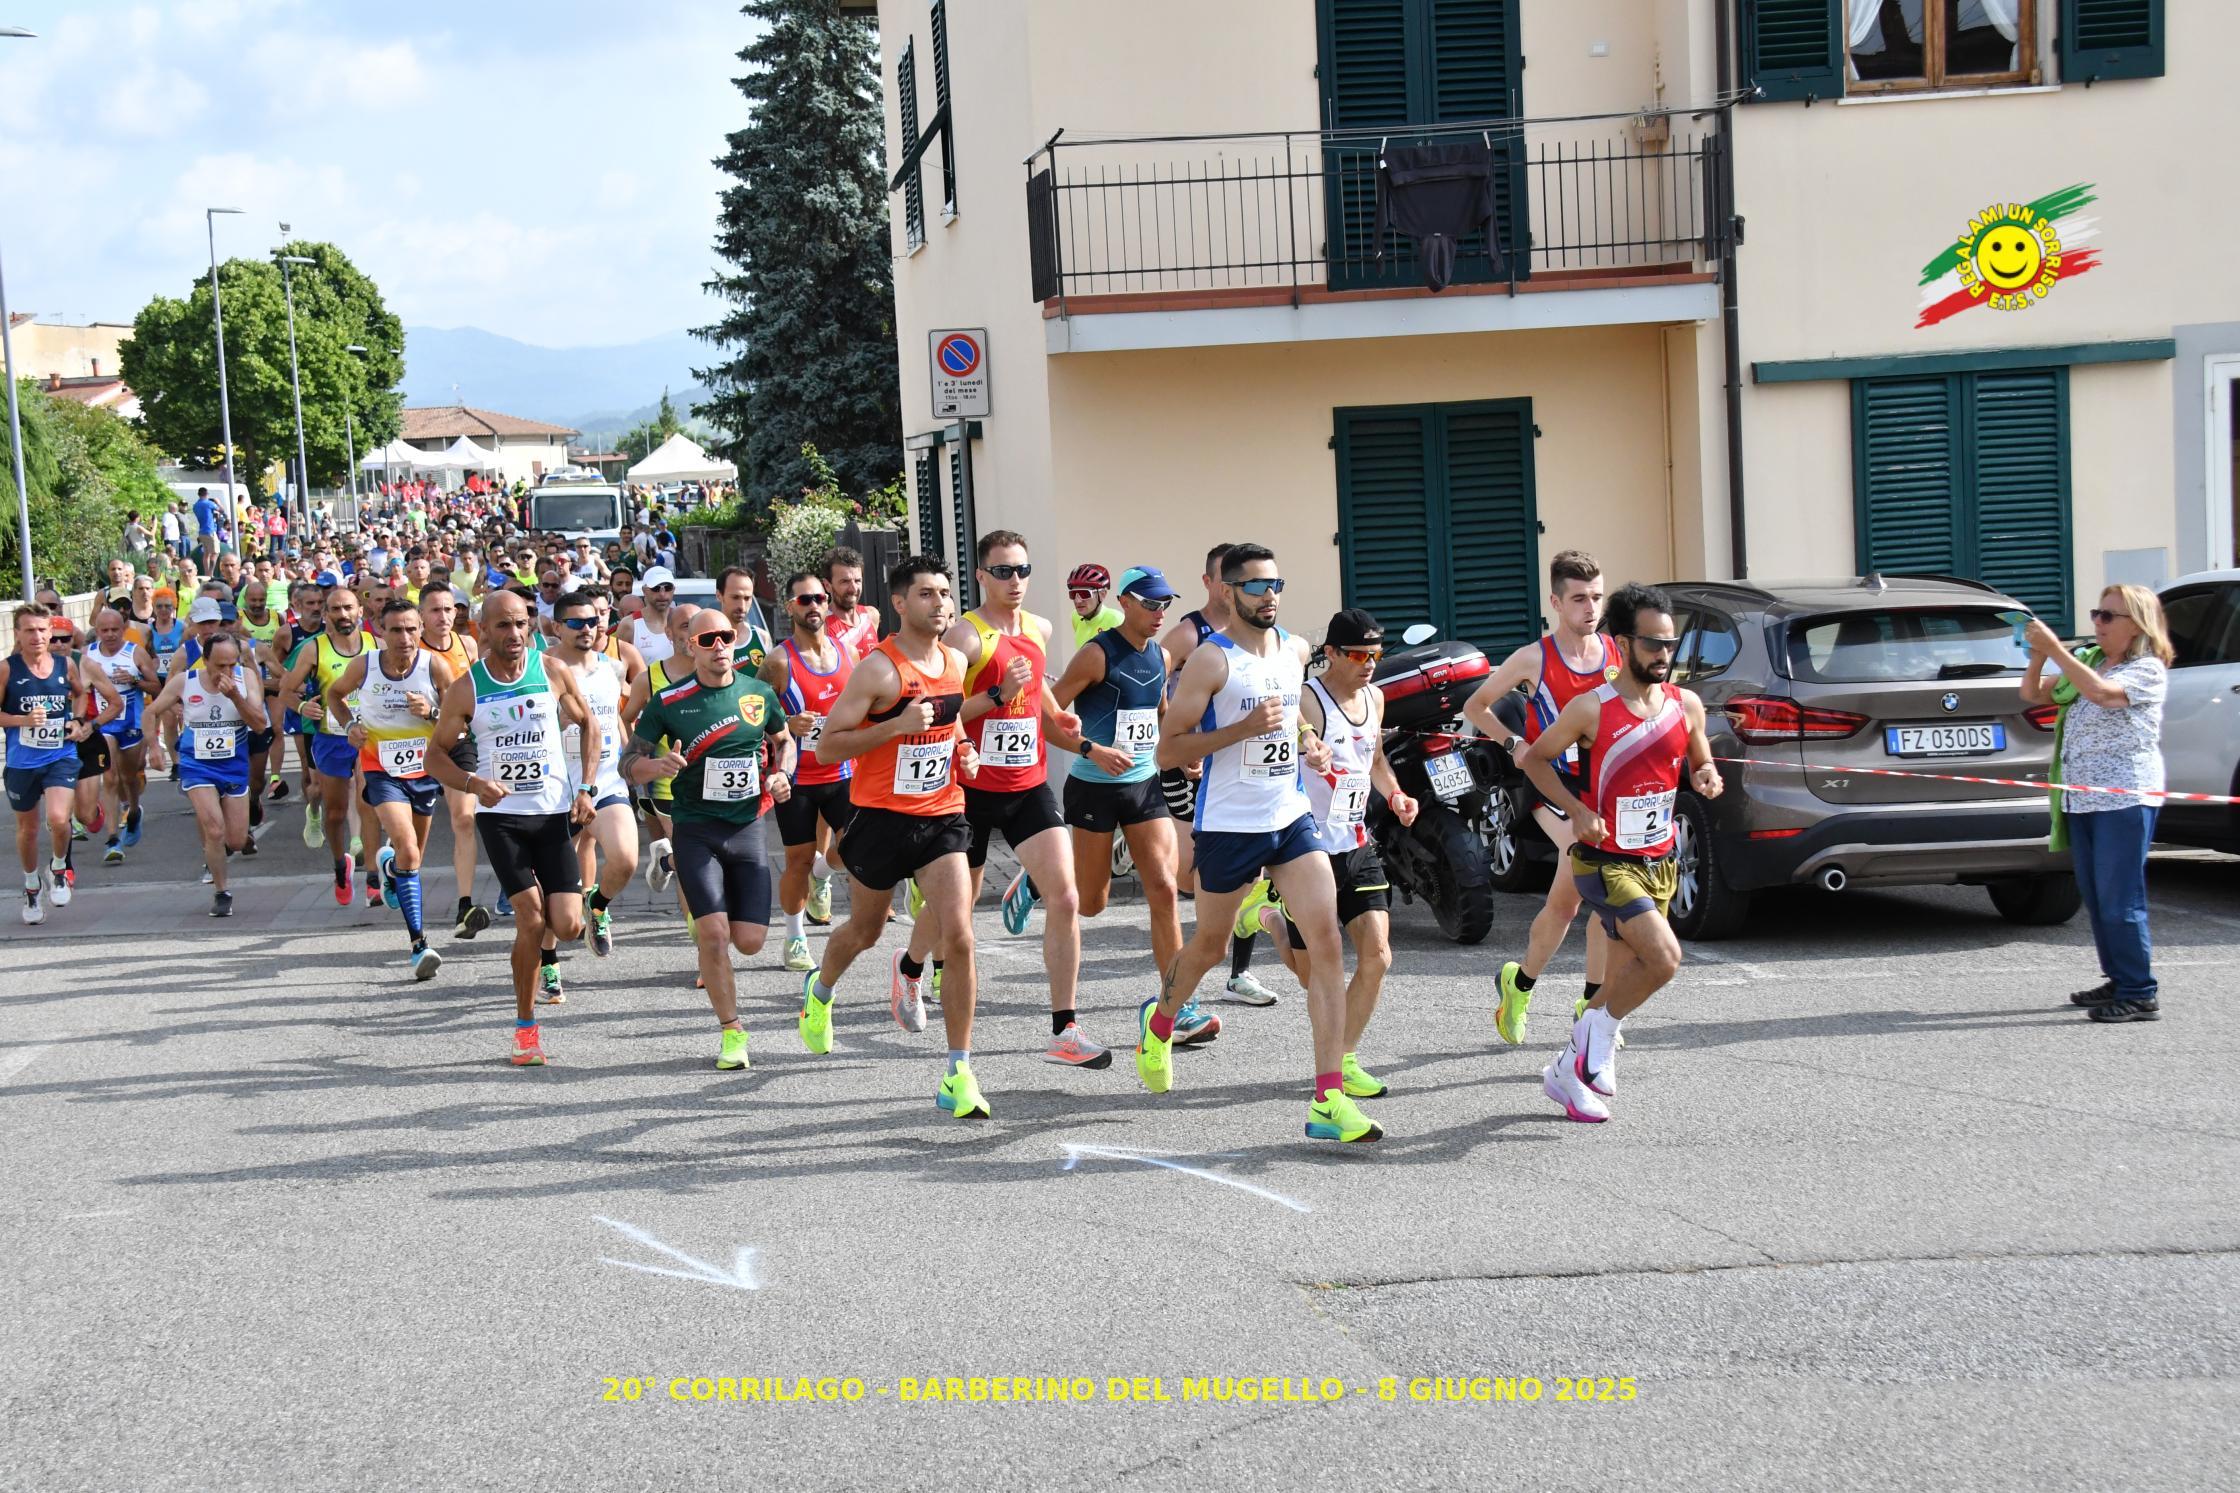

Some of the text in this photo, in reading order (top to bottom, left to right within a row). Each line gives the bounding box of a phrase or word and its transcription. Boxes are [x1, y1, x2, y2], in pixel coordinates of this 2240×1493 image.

[20, 694, 65, 703] COMPUTER
[710, 714, 740, 731] ELLERA
[28, 728, 58, 740] 104
[1127, 723, 1153, 740] 130
[1901, 730, 1925, 750] FZ
[1932, 727, 1991, 748] 030DS
[206, 737, 225, 750] 62
[389, 739, 426, 750] CORRILAGO
[994, 734, 1030, 752] 129
[394, 750, 415, 765] 69
[501, 749, 547, 761] CORRILAGO
[1263, 742, 1290, 763] 28
[501, 762, 541, 781] 223
[718, 760, 752, 769] CORRILA
[910, 756, 947, 779] 127
[1434, 757, 1449, 772] EY
[722, 771, 749, 788] 33
[1434, 770, 1471, 792] 94832
[1821, 779, 1849, 788] X1
[1646, 811, 1657, 831] 2
